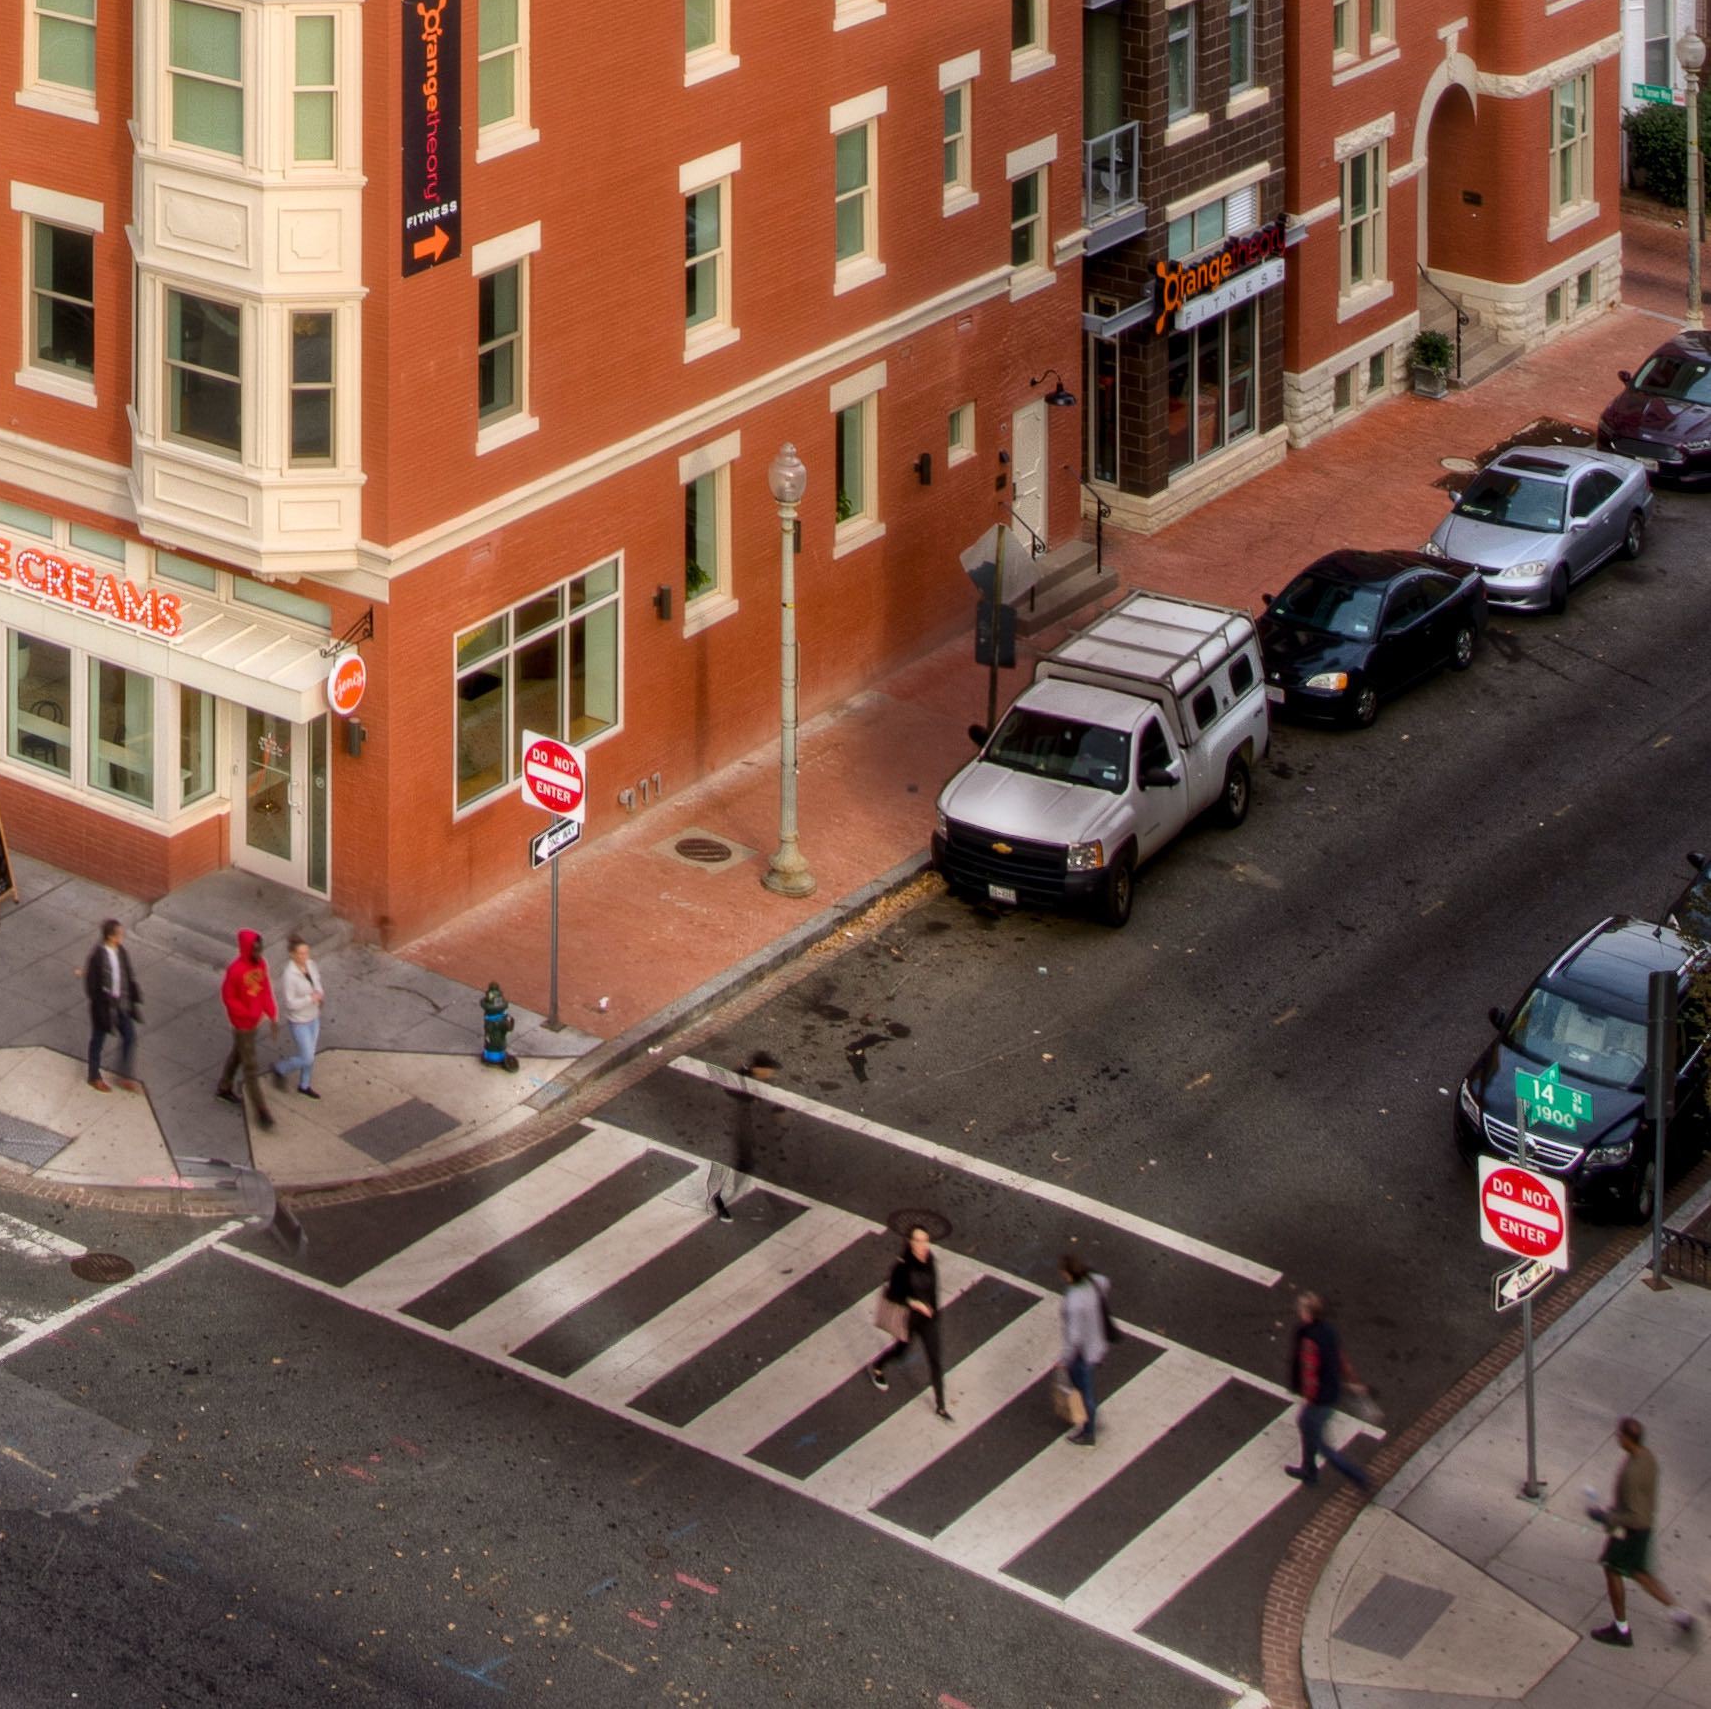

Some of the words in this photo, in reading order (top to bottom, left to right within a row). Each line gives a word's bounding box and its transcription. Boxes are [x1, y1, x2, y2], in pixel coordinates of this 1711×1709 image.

[406, 199, 458, 229] FITNESS
[1185, 265, 1283, 325] FITNESS
[17, 548, 183, 636] CREAMS
[532, 748, 548, 764] DO
[554, 756, 576, 775] NOT
[536, 780, 572, 804] ENTER
[547, 835, 561, 851] ONE
[562, 823, 576, 841] WAY
[1533, 1079, 1554, 1104] 14
[1535, 1104, 1575, 1128] 1900
[1492, 1177, 1513, 1196] DO
[1522, 1187, 1551, 1209] NOT
[1499, 1216, 1547, 1246] ENTER
